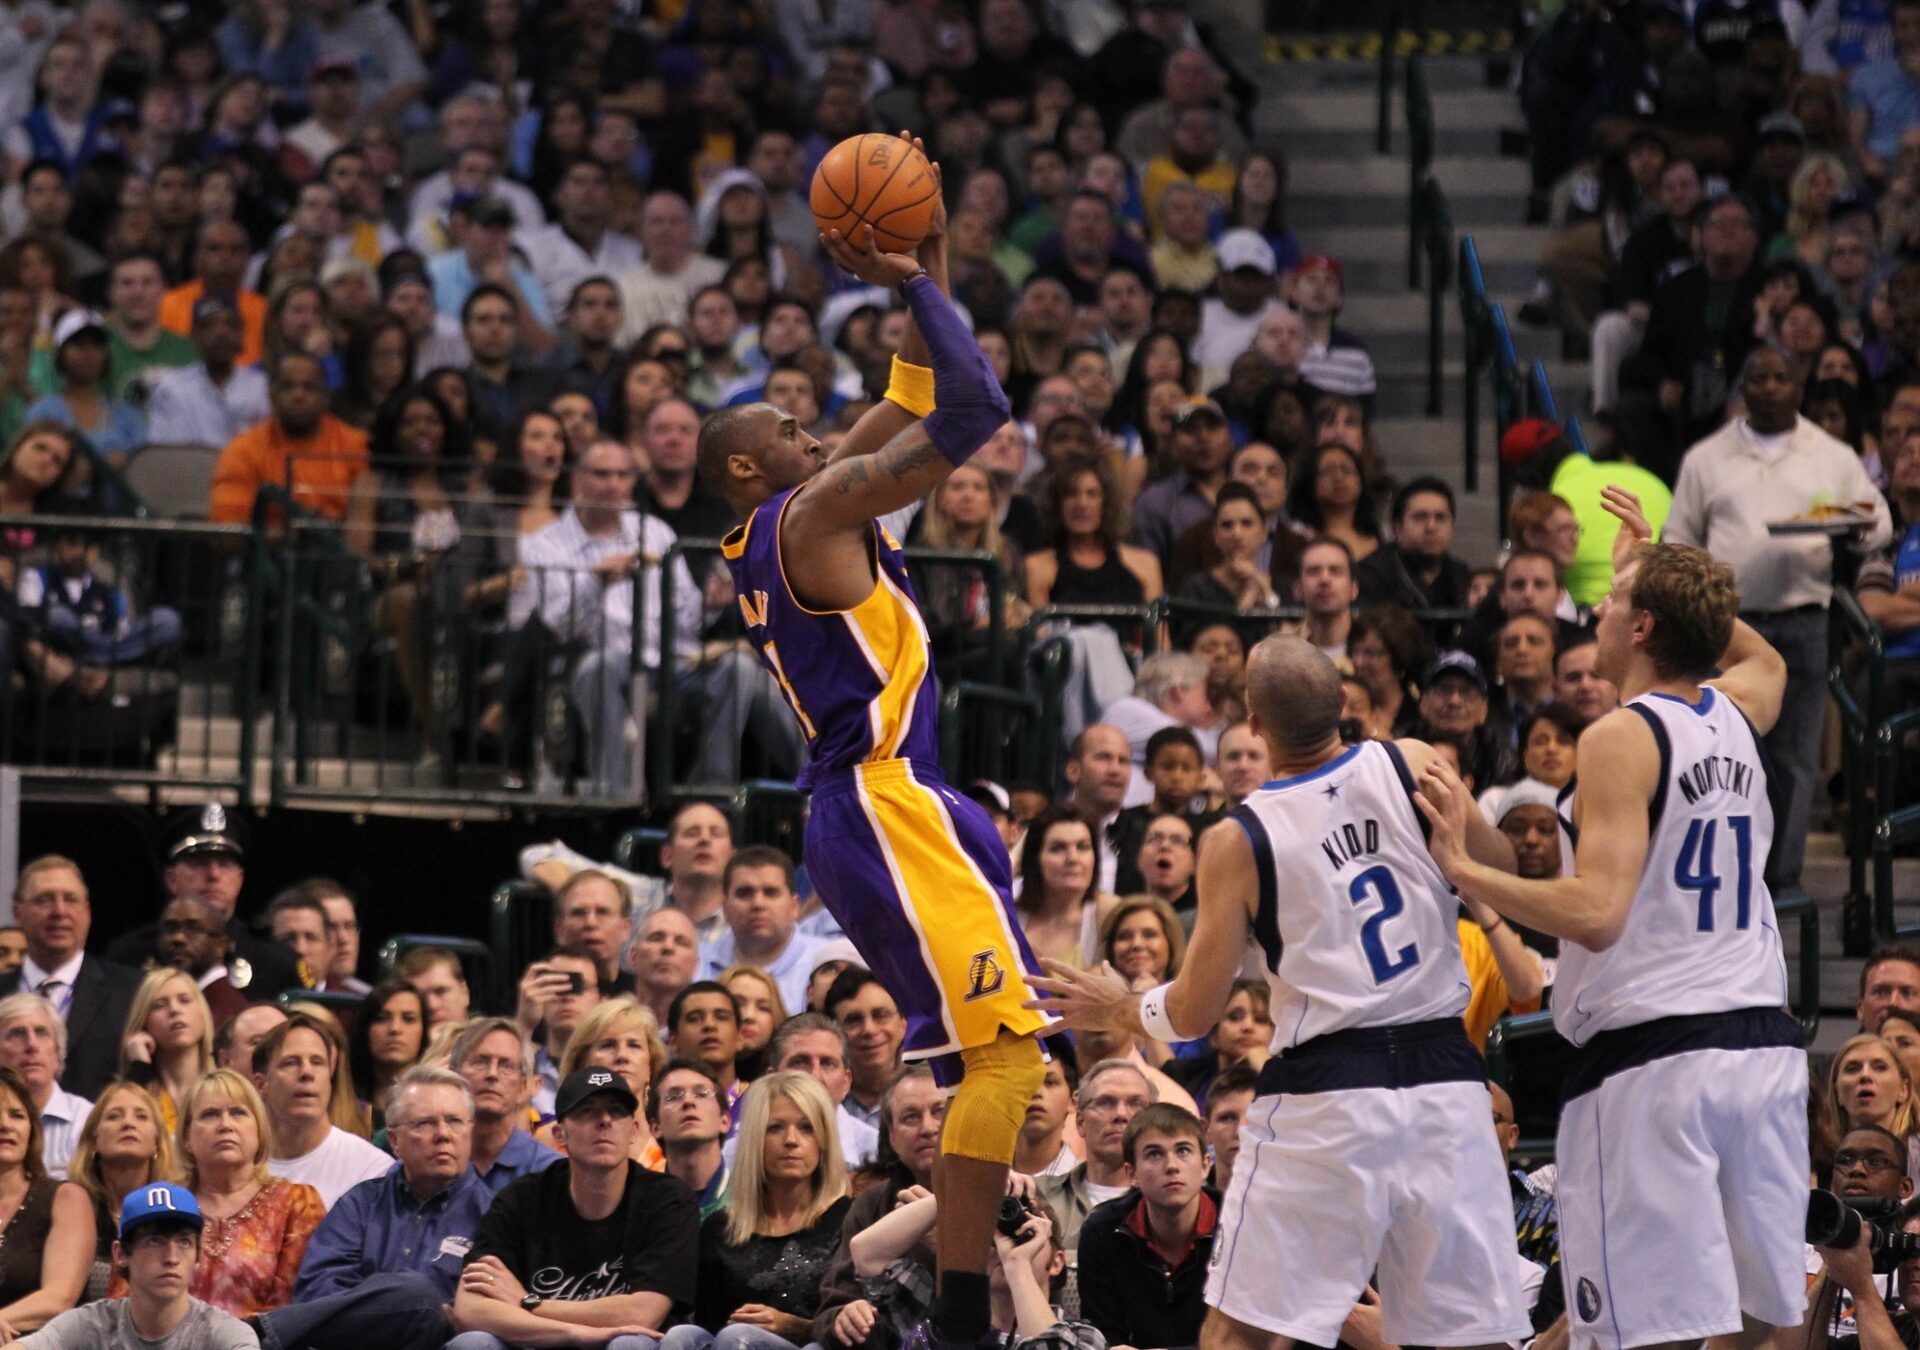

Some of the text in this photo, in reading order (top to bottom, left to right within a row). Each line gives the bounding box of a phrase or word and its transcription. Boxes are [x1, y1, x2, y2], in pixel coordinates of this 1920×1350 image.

[1321, 819, 1379, 872] KIDD
[1673, 815, 1752, 933] 41
[1348, 864, 1421, 987] 2
